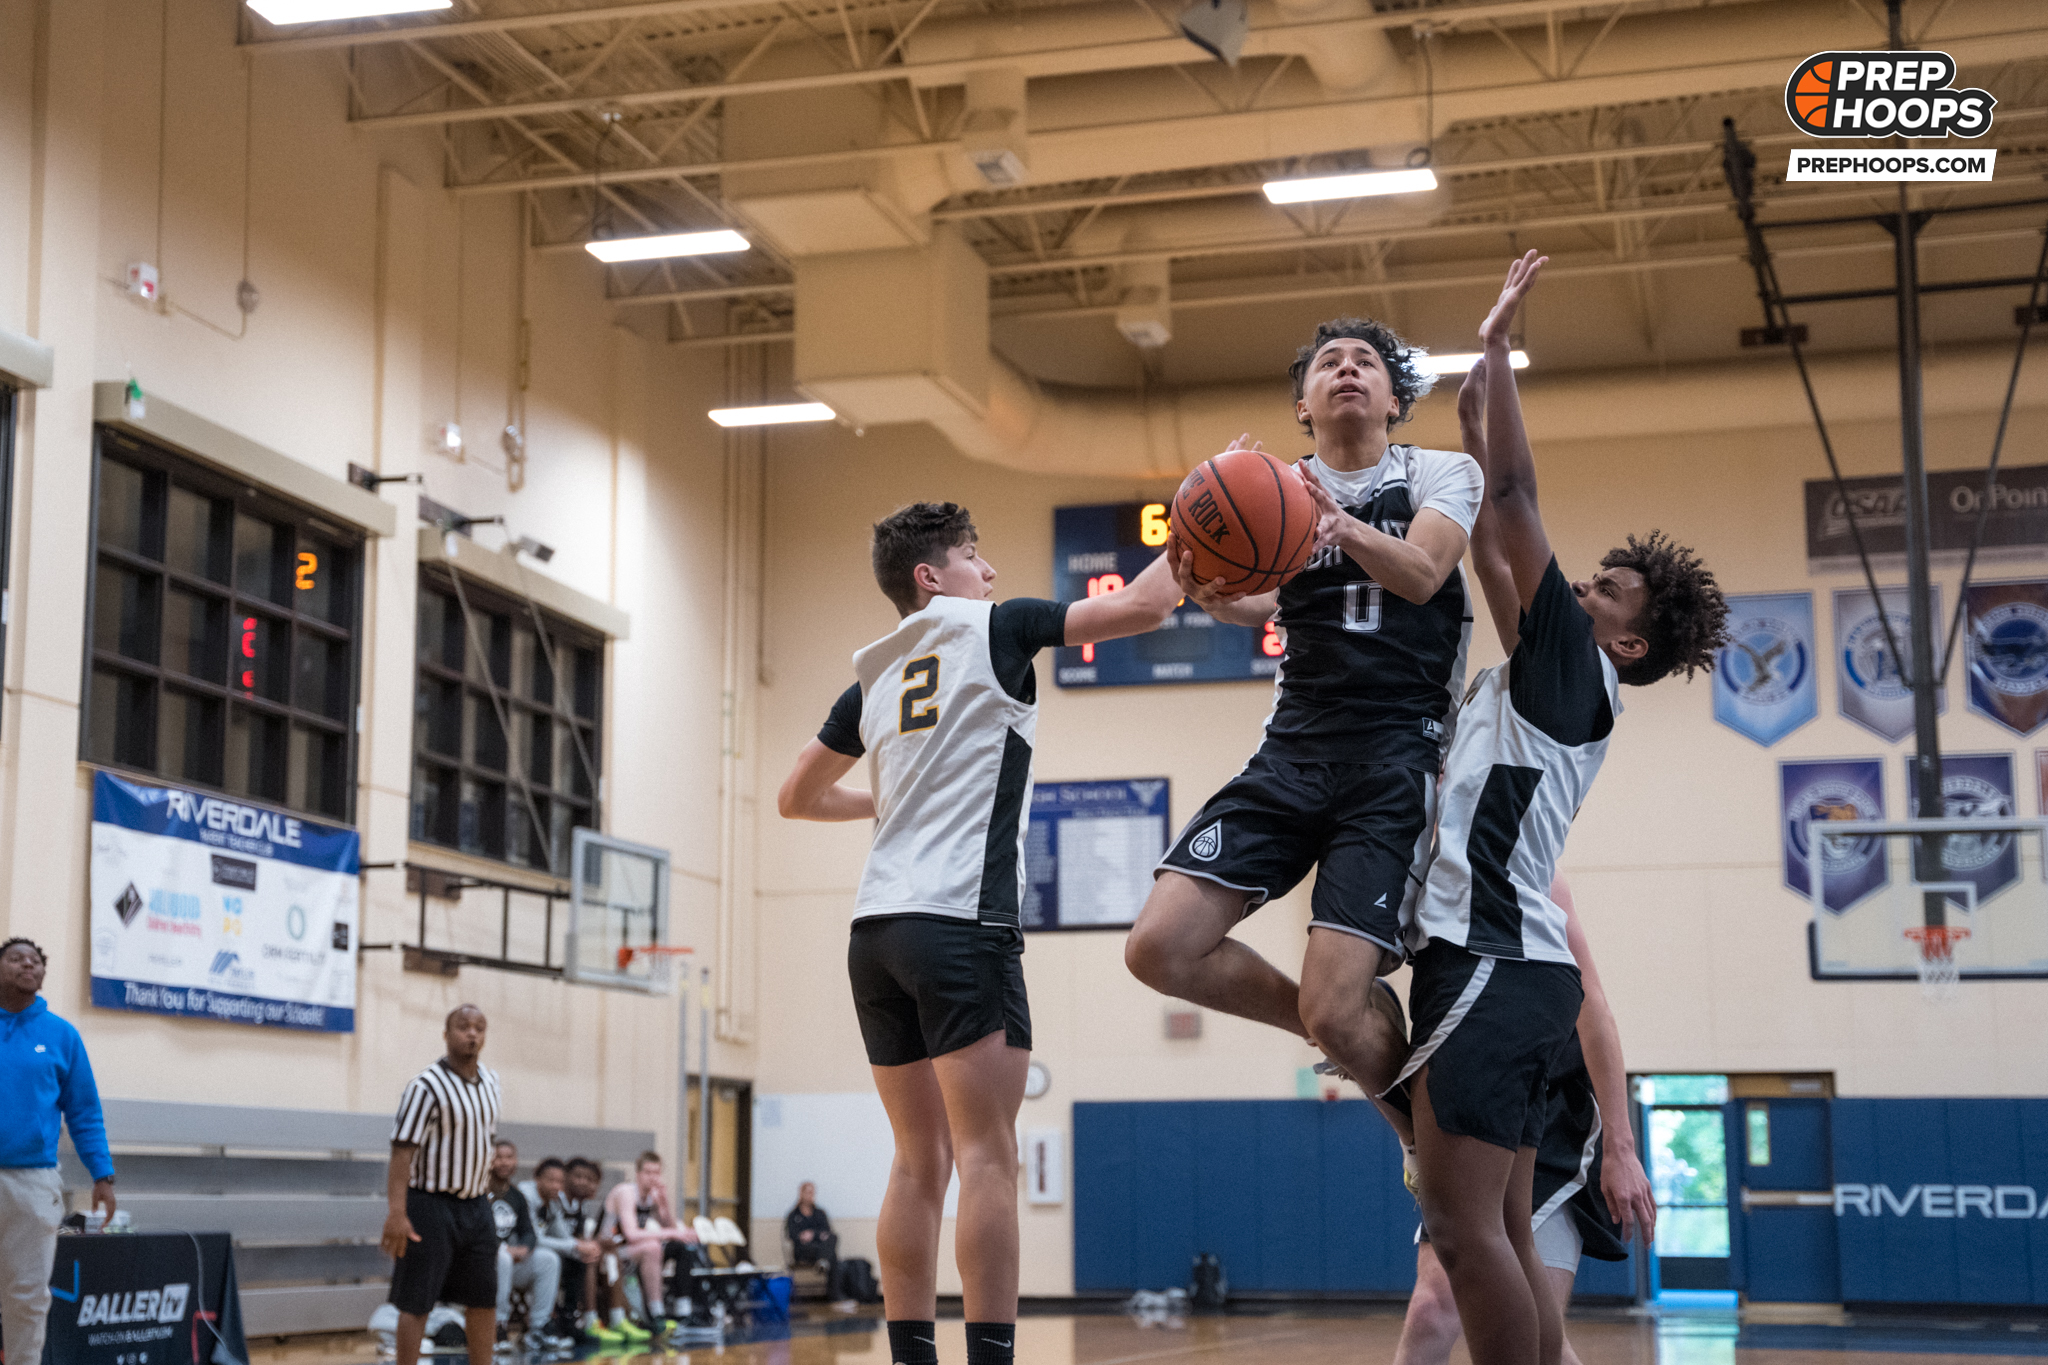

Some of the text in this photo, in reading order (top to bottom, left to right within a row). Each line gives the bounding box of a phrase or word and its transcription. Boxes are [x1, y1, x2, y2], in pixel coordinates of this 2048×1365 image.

[1188, 488, 1230, 545] ROCK
[899, 653, 940, 735] 2
[166, 790, 303, 848] RIVERDALE
[124, 981, 159, 1006] Thank
[187, 987, 206, 1011] for
[206, 990, 265, 1024] Supporting
[264, 1002, 285, 1021] our
